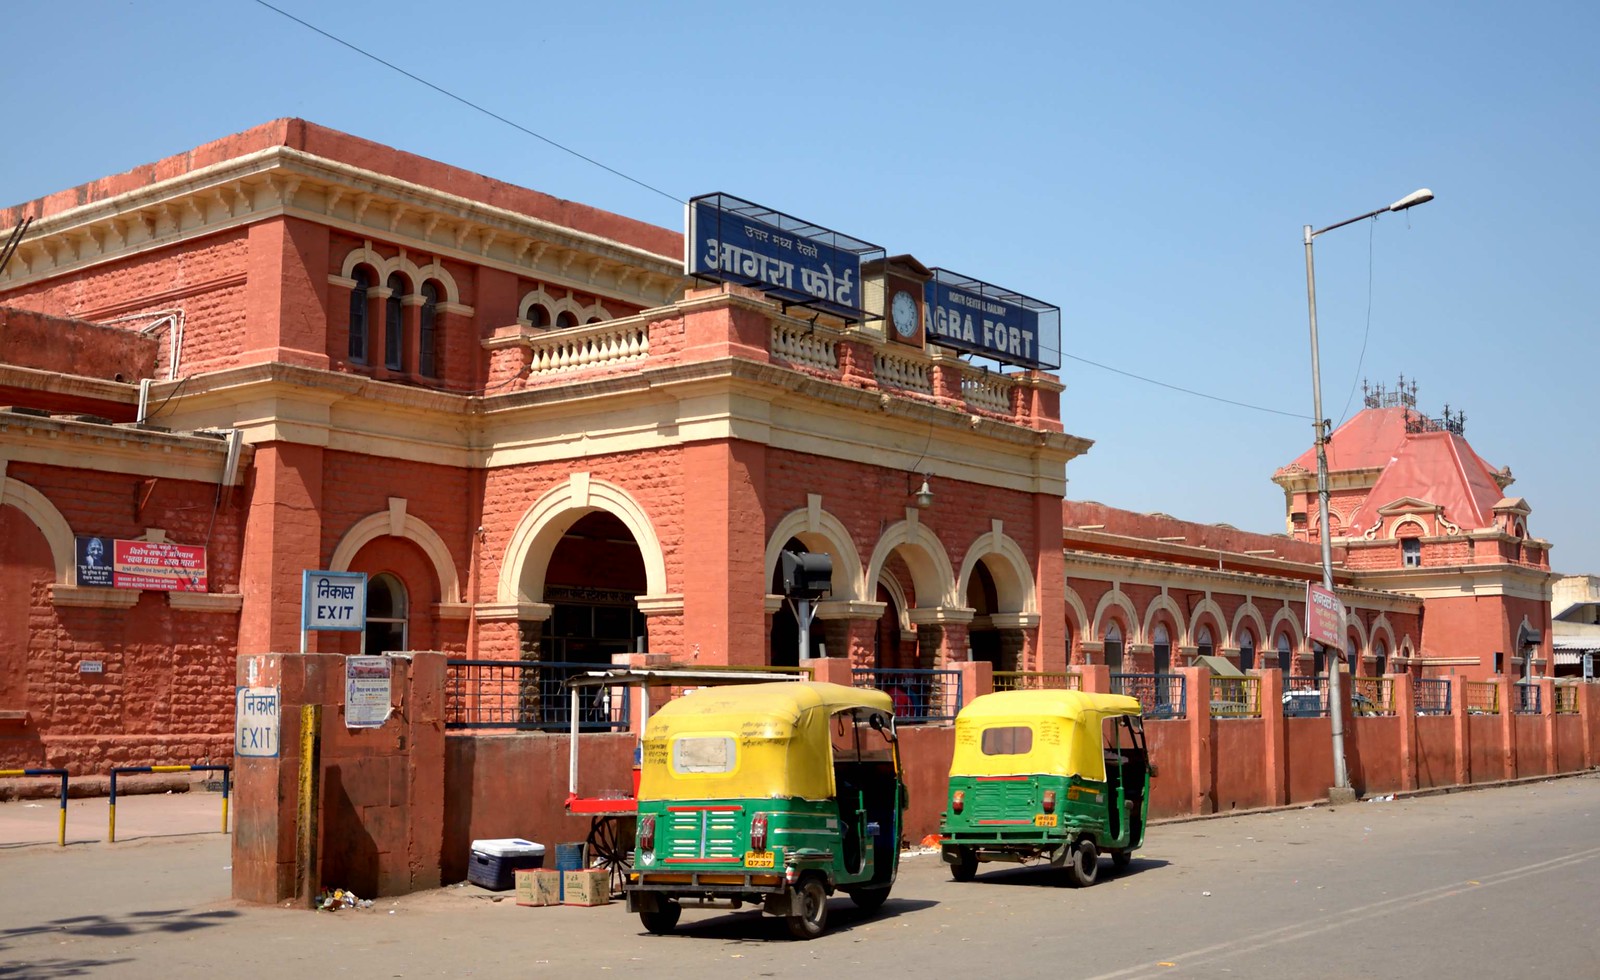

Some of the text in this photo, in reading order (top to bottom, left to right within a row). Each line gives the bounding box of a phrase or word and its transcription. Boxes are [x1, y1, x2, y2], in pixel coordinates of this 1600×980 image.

[744, 225, 818, 259] उत्तर मध्य रेलवे
[704, 238, 853, 307] आगरा फोर्ट
[949, 291, 966, 306] NORTH
[925, 302, 1033, 359] AGRA FORT
[130, 547, 148, 556] विशेष
[150, 549, 167, 557] सफाई
[143, 556, 159, 564] भारत
[317, 578, 355, 599] निकास
[317, 605, 354, 620] EXIT
[244, 689, 276, 716] निकास
[241, 726, 271, 749] EXIT
